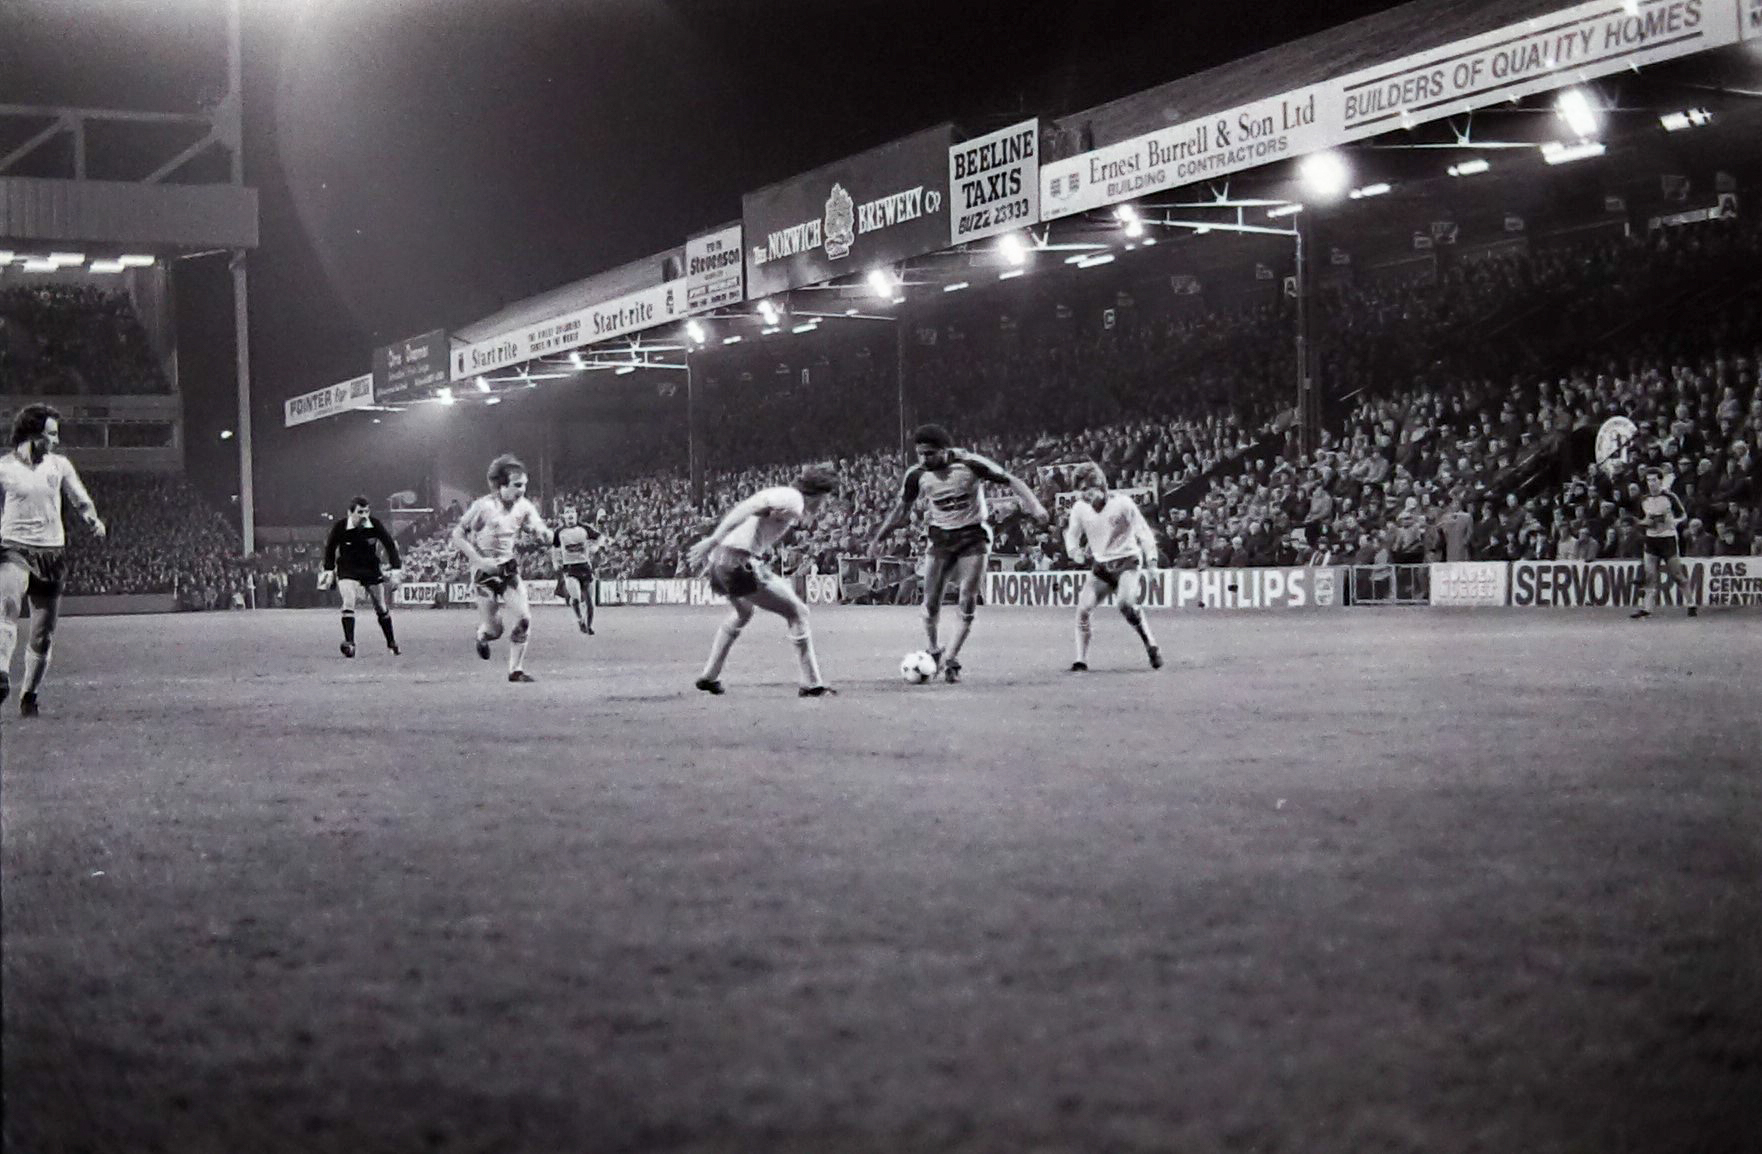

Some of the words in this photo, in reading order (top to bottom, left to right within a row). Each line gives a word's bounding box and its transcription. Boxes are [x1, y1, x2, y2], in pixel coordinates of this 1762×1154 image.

[1345, 70, 1444, 119] BUILDERS
[1453, 58, 1485, 89] OF
[1492, 26, 1594, 78] QUALITY
[1605, 0, 1701, 48] HOMES
[954, 130, 1034, 180] BEELINE
[1089, 153, 1141, 184] Ernest
[1148, 125, 1208, 168] Burrell
[1216, 120, 1230, 148] &
[1239, 112, 1274, 141] Son
[1282, 94, 1315, 130] Ltd
[1107, 170, 1165, 197] BUILDING
[1177, 136, 1288, 178] CONTRACTORS
[962, 167, 1021, 209] TAXIS
[767, 218, 822, 261] NORWICH
[857, 186, 924, 235] BREWERY
[958, 209, 991, 235] BUZZ
[690, 248, 740, 275] Stevenson
[593, 302, 653, 335] Start-rite
[472, 341, 518, 369] Startrite
[1710, 562, 1747, 576] GAS
[991, 573, 1088, 606] NORWICH
[1177, 570, 1307, 607] PHILIPS
